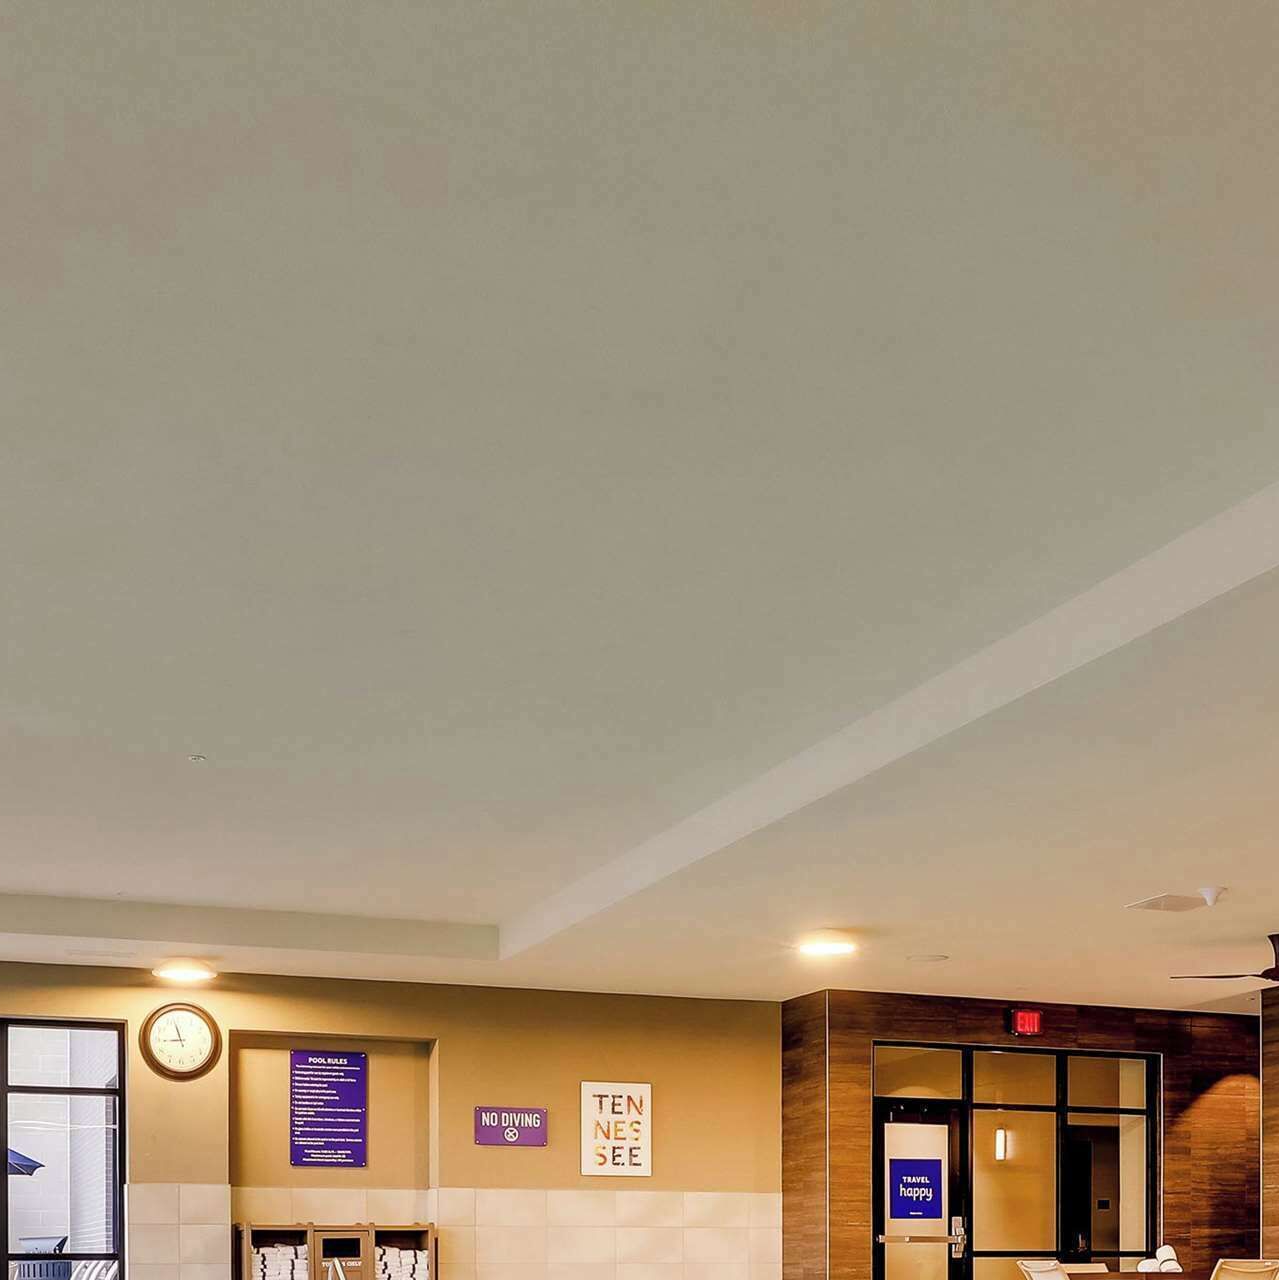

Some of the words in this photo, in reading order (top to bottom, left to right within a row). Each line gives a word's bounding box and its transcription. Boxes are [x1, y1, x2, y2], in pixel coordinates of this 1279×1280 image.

[1017, 1012, 1038, 1032] EXIT
[592, 1094, 643, 1116] TEN
[481, 1112, 498, 1126] NO
[502, 1113, 541, 1128] DIVING
[593, 1120, 642, 1141] NES
[594, 1146, 642, 1167] SEE
[902, 1176, 930, 1184] TRAVEL
[900, 1184, 933, 1201] happy
